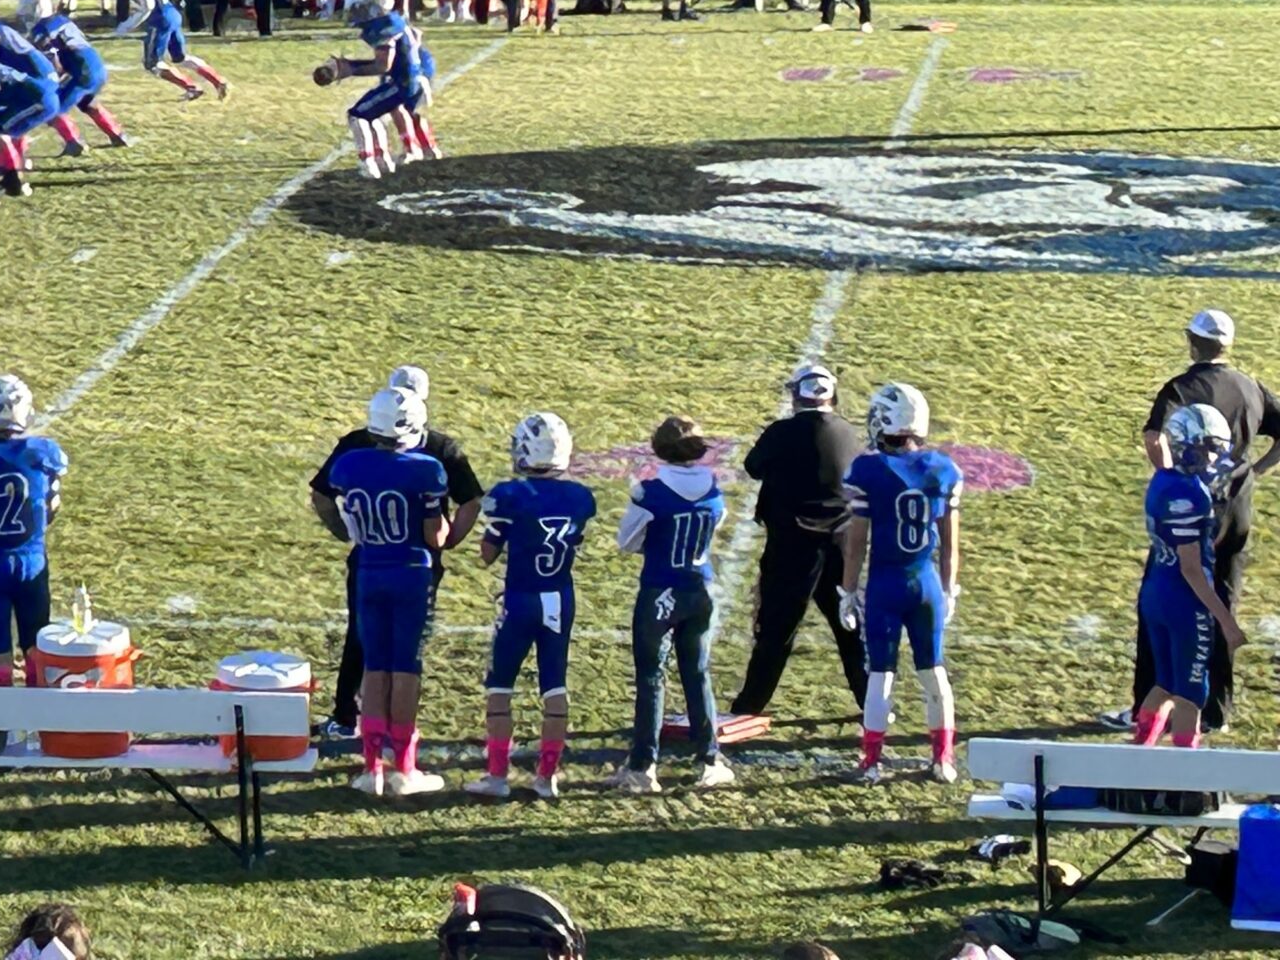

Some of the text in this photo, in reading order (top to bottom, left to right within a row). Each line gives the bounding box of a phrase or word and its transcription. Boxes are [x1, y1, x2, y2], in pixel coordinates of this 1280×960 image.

[535, 516, 571, 577] 3
[671, 511, 712, 568] 11
[895, 488, 930, 553] 8
